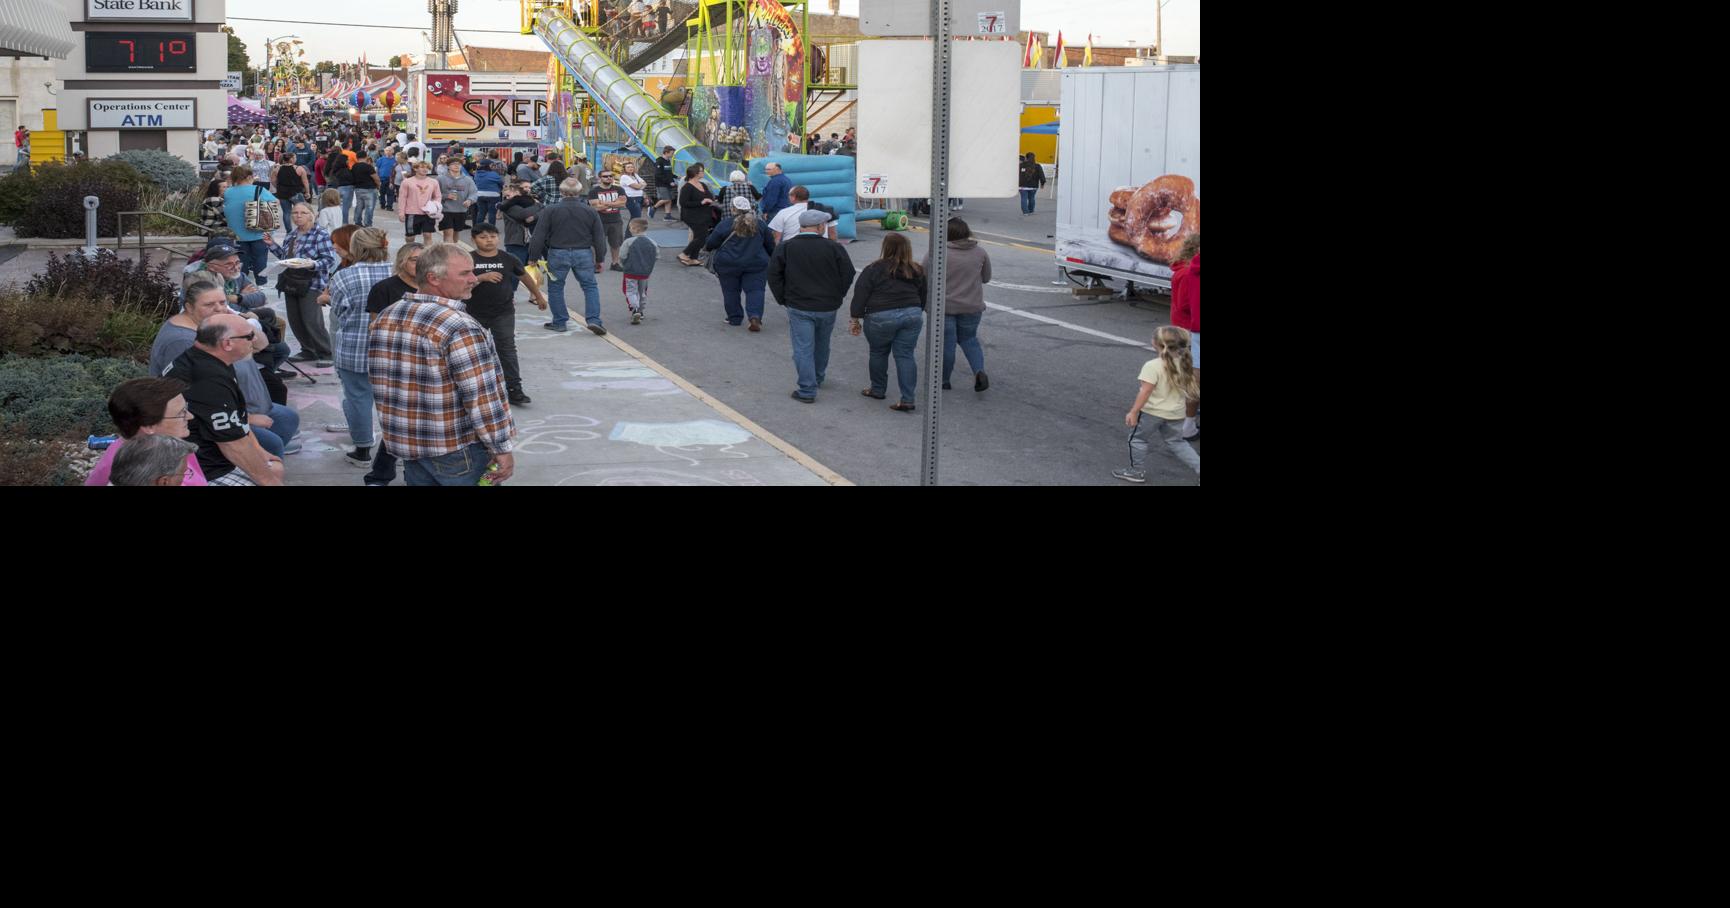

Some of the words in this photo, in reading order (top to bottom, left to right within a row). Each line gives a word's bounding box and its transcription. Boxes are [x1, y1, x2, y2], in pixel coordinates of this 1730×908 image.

[94, 0, 134, 10] State
[139, 0, 183, 10] Bank
[985, 16, 998, 32] 7
[93, 102, 152, 112] Operations
[154, 102, 191, 111] Center
[121, 114, 163, 126] ATM
[869, 177, 881, 194] 7
[211, 409, 242, 431] 24
